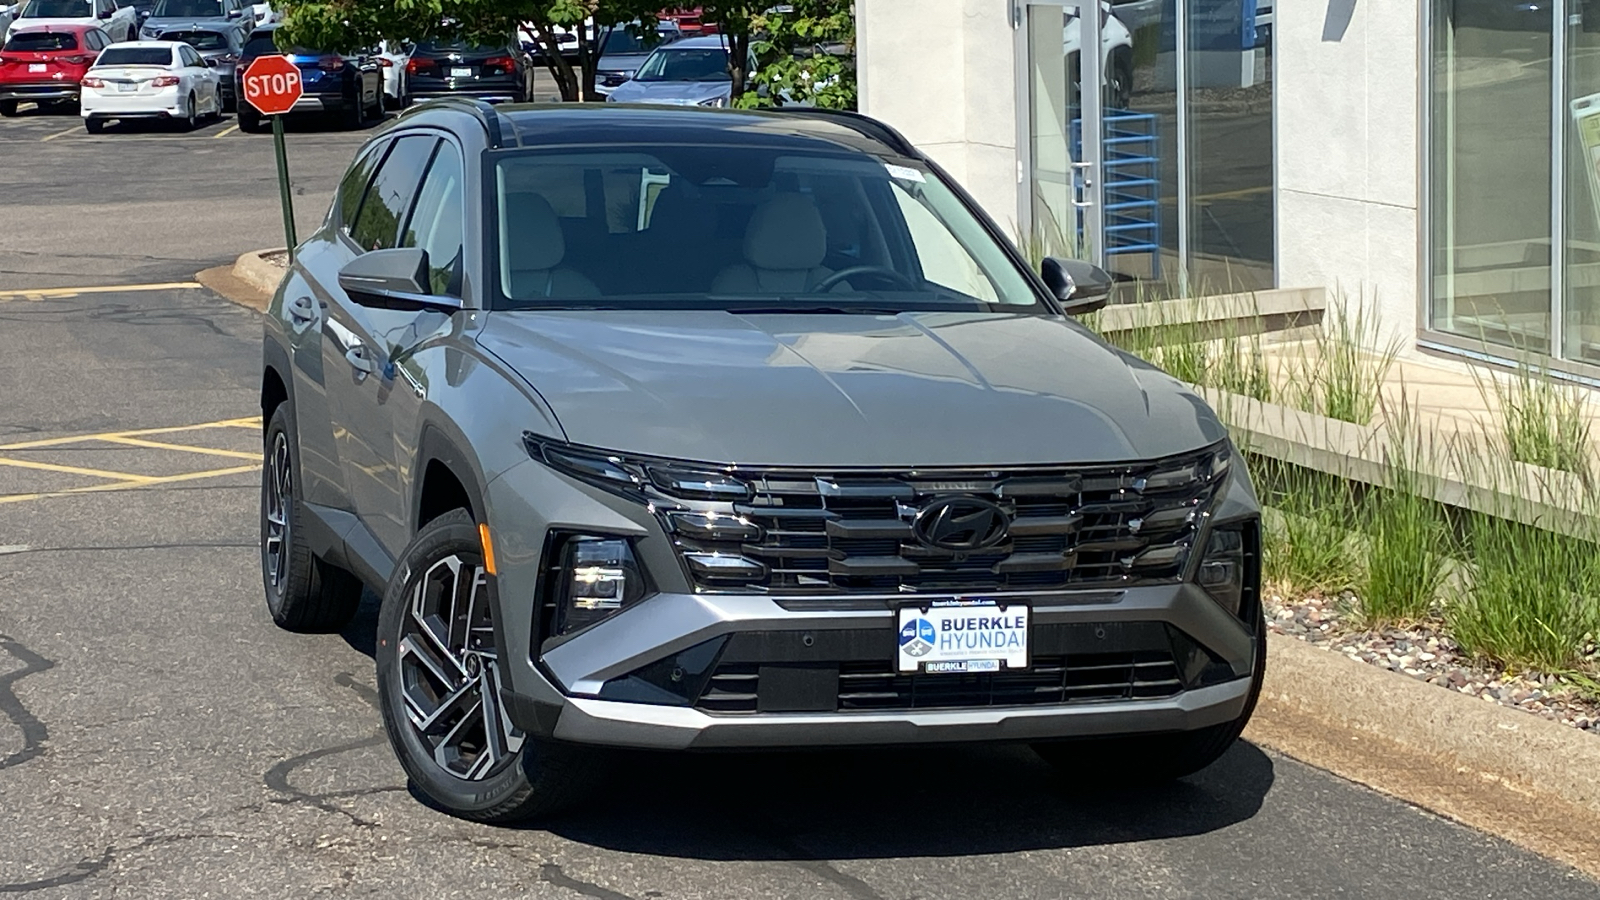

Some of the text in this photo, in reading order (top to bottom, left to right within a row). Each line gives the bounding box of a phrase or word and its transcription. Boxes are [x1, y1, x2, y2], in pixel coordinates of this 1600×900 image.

[247, 72, 298, 97] STOP
[941, 616, 1025, 631] BUERKLE
[940, 630, 1025, 650] HYUNDAI
[927, 660, 998, 671] BUERKLE HYUNDAI
